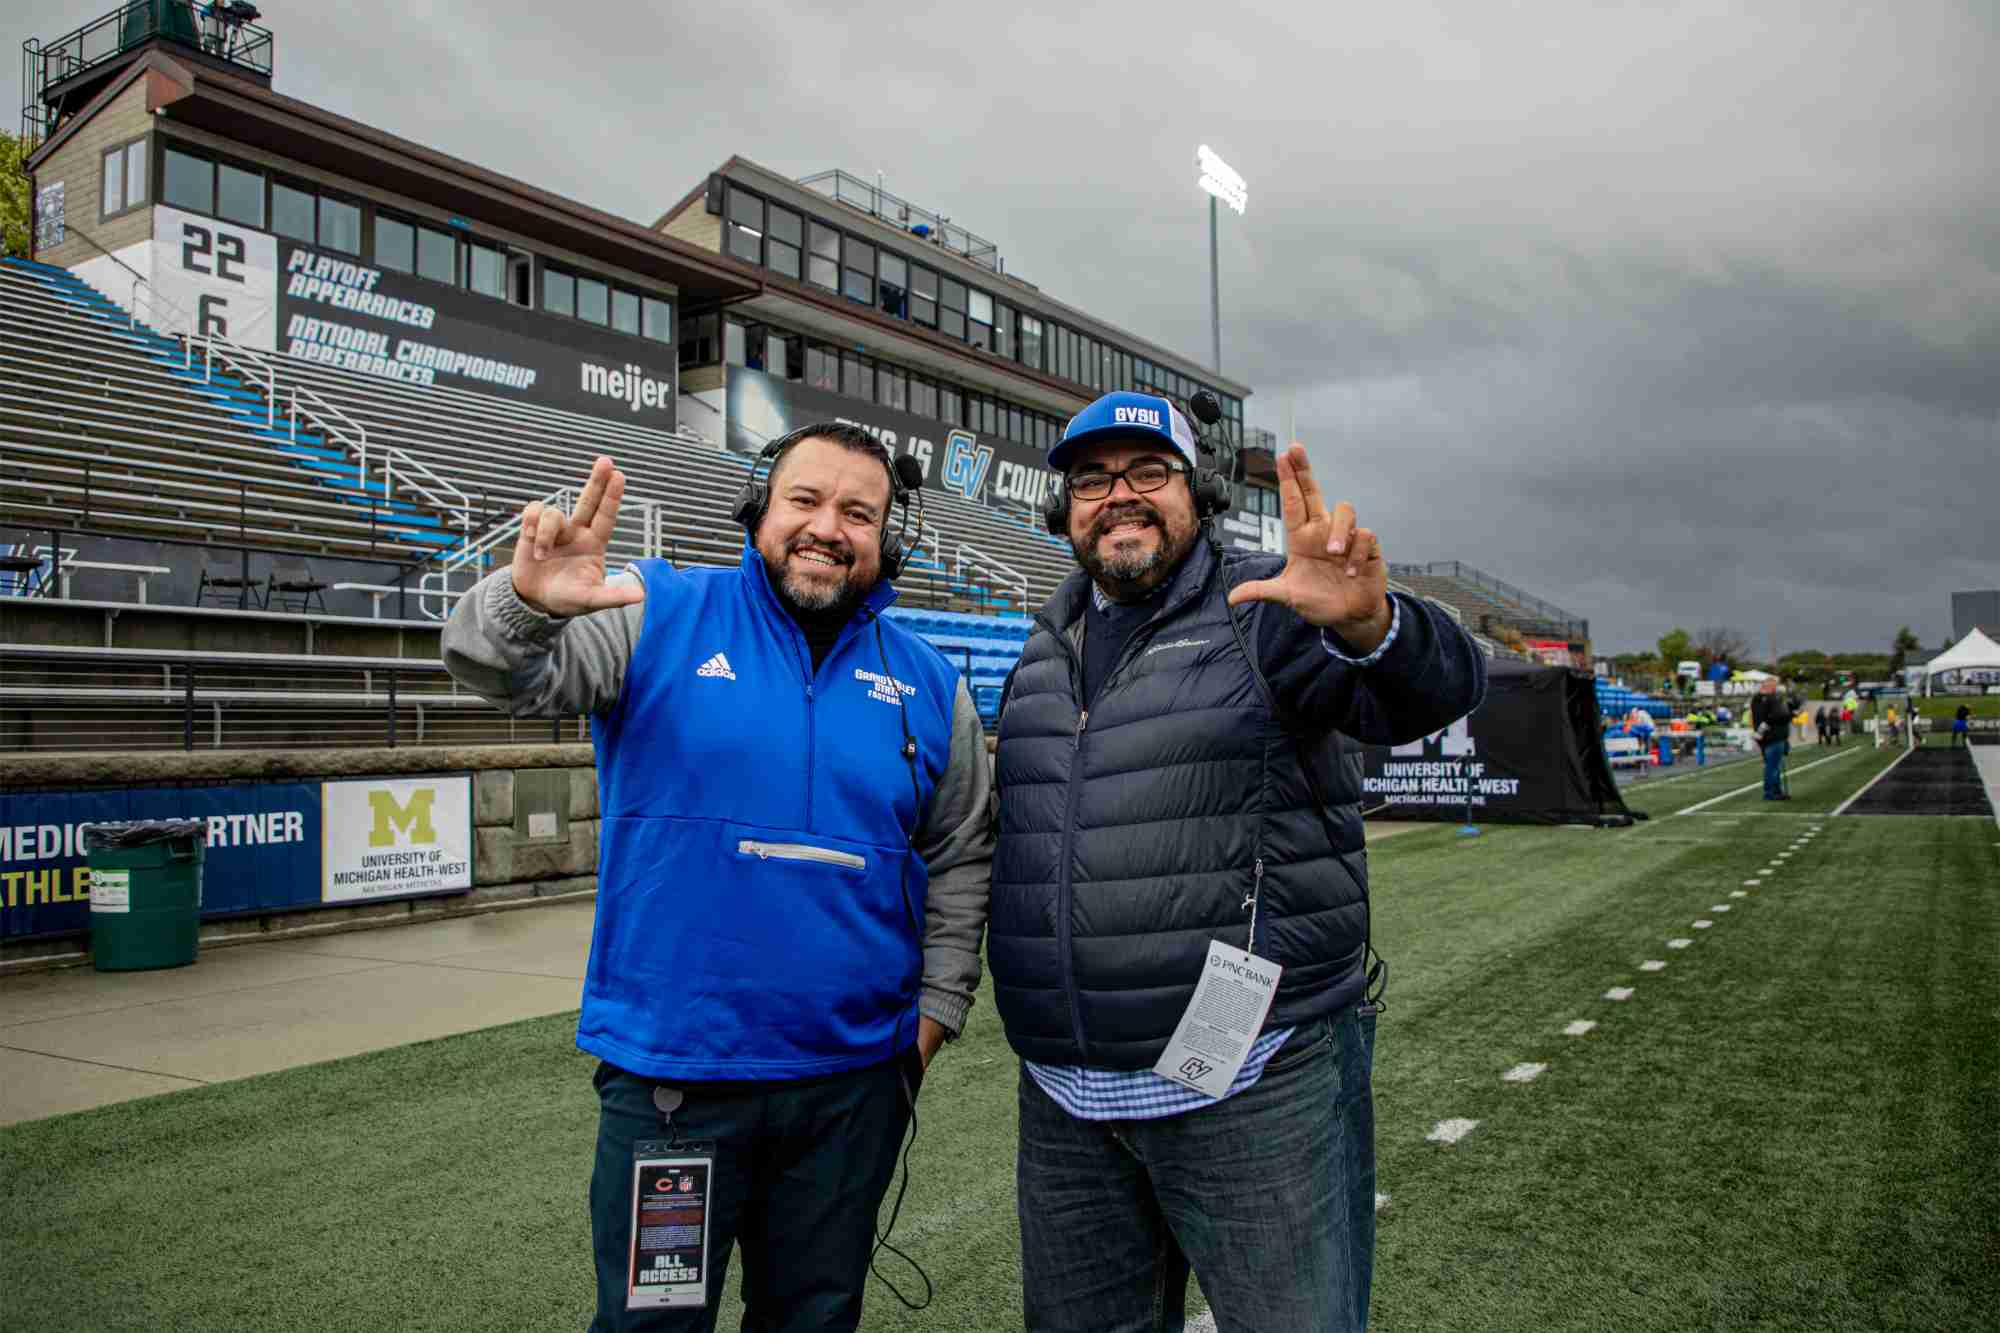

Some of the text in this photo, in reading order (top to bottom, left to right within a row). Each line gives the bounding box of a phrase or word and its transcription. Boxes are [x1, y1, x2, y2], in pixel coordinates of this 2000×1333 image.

[182, 222, 245, 284] 22
[287, 249, 382, 291] PLAYOFF
[286, 273, 435, 330] APPEARANCES
[286, 313, 537, 391] NATIONAL CHAMPIONSHIP
[287, 339, 436, 386] APPEARANCES
[580, 361, 670, 413] meijer
[1114, 406, 1160, 426] GVSU
[1383, 762, 1463, 778] UNIVERSITY
[1362, 777, 1420, 793] ICHIGAN
[1436, 795, 1487, 807] MEDICNE
[368, 789, 435, 847] M
[361, 849, 443, 869] UNIVERSITY OF
[333, 861, 468, 886] MICHIGAN HEALTH-WEST
[654, 1254, 685, 1269] ALL
[639, 1267, 698, 1284] ACCESS
